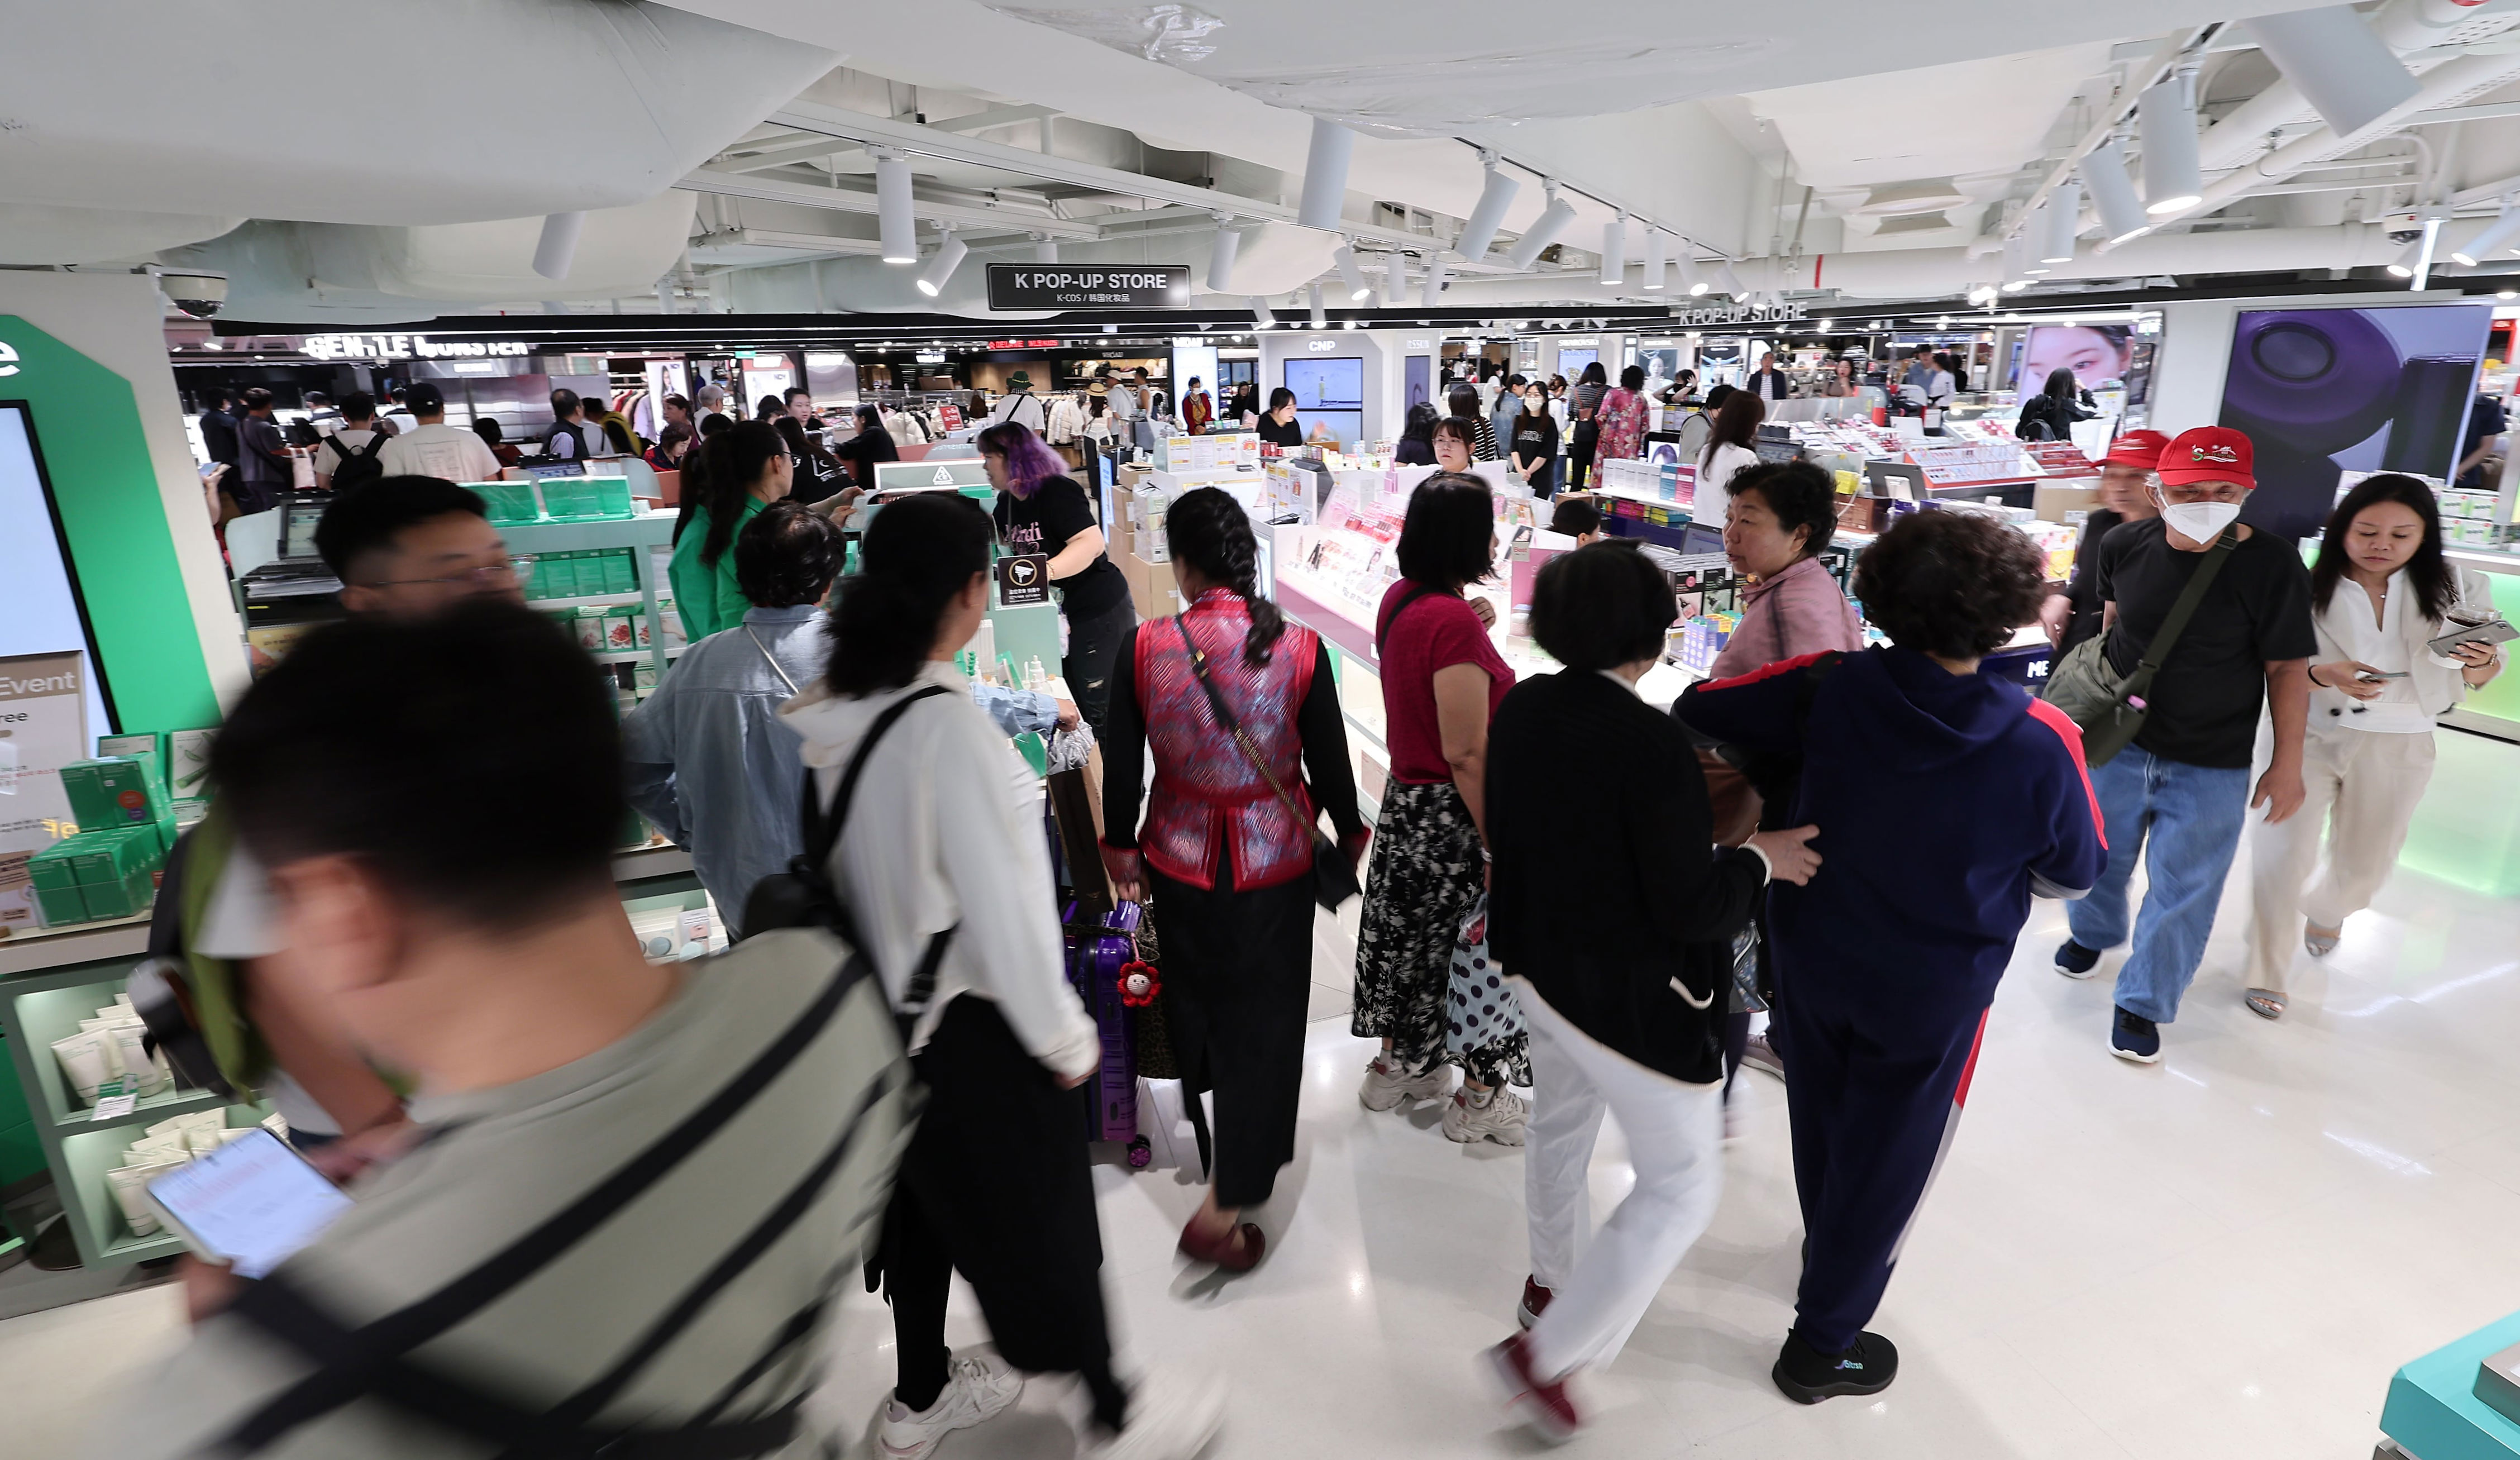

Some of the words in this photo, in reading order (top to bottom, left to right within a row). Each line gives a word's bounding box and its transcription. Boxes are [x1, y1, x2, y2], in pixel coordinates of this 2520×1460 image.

[1014, 273, 1029, 288] K
[1034, 273, 1105, 289] POP-UP
[1108, 274, 1167, 289] STORE
[1679, 309, 1690, 325] K
[1692, 307, 1749, 324] POP-UP
[1750, 301, 1807, 322] STORE
[1309, 341, 1336, 352] CNP
[0, 671, 76, 696] Event
